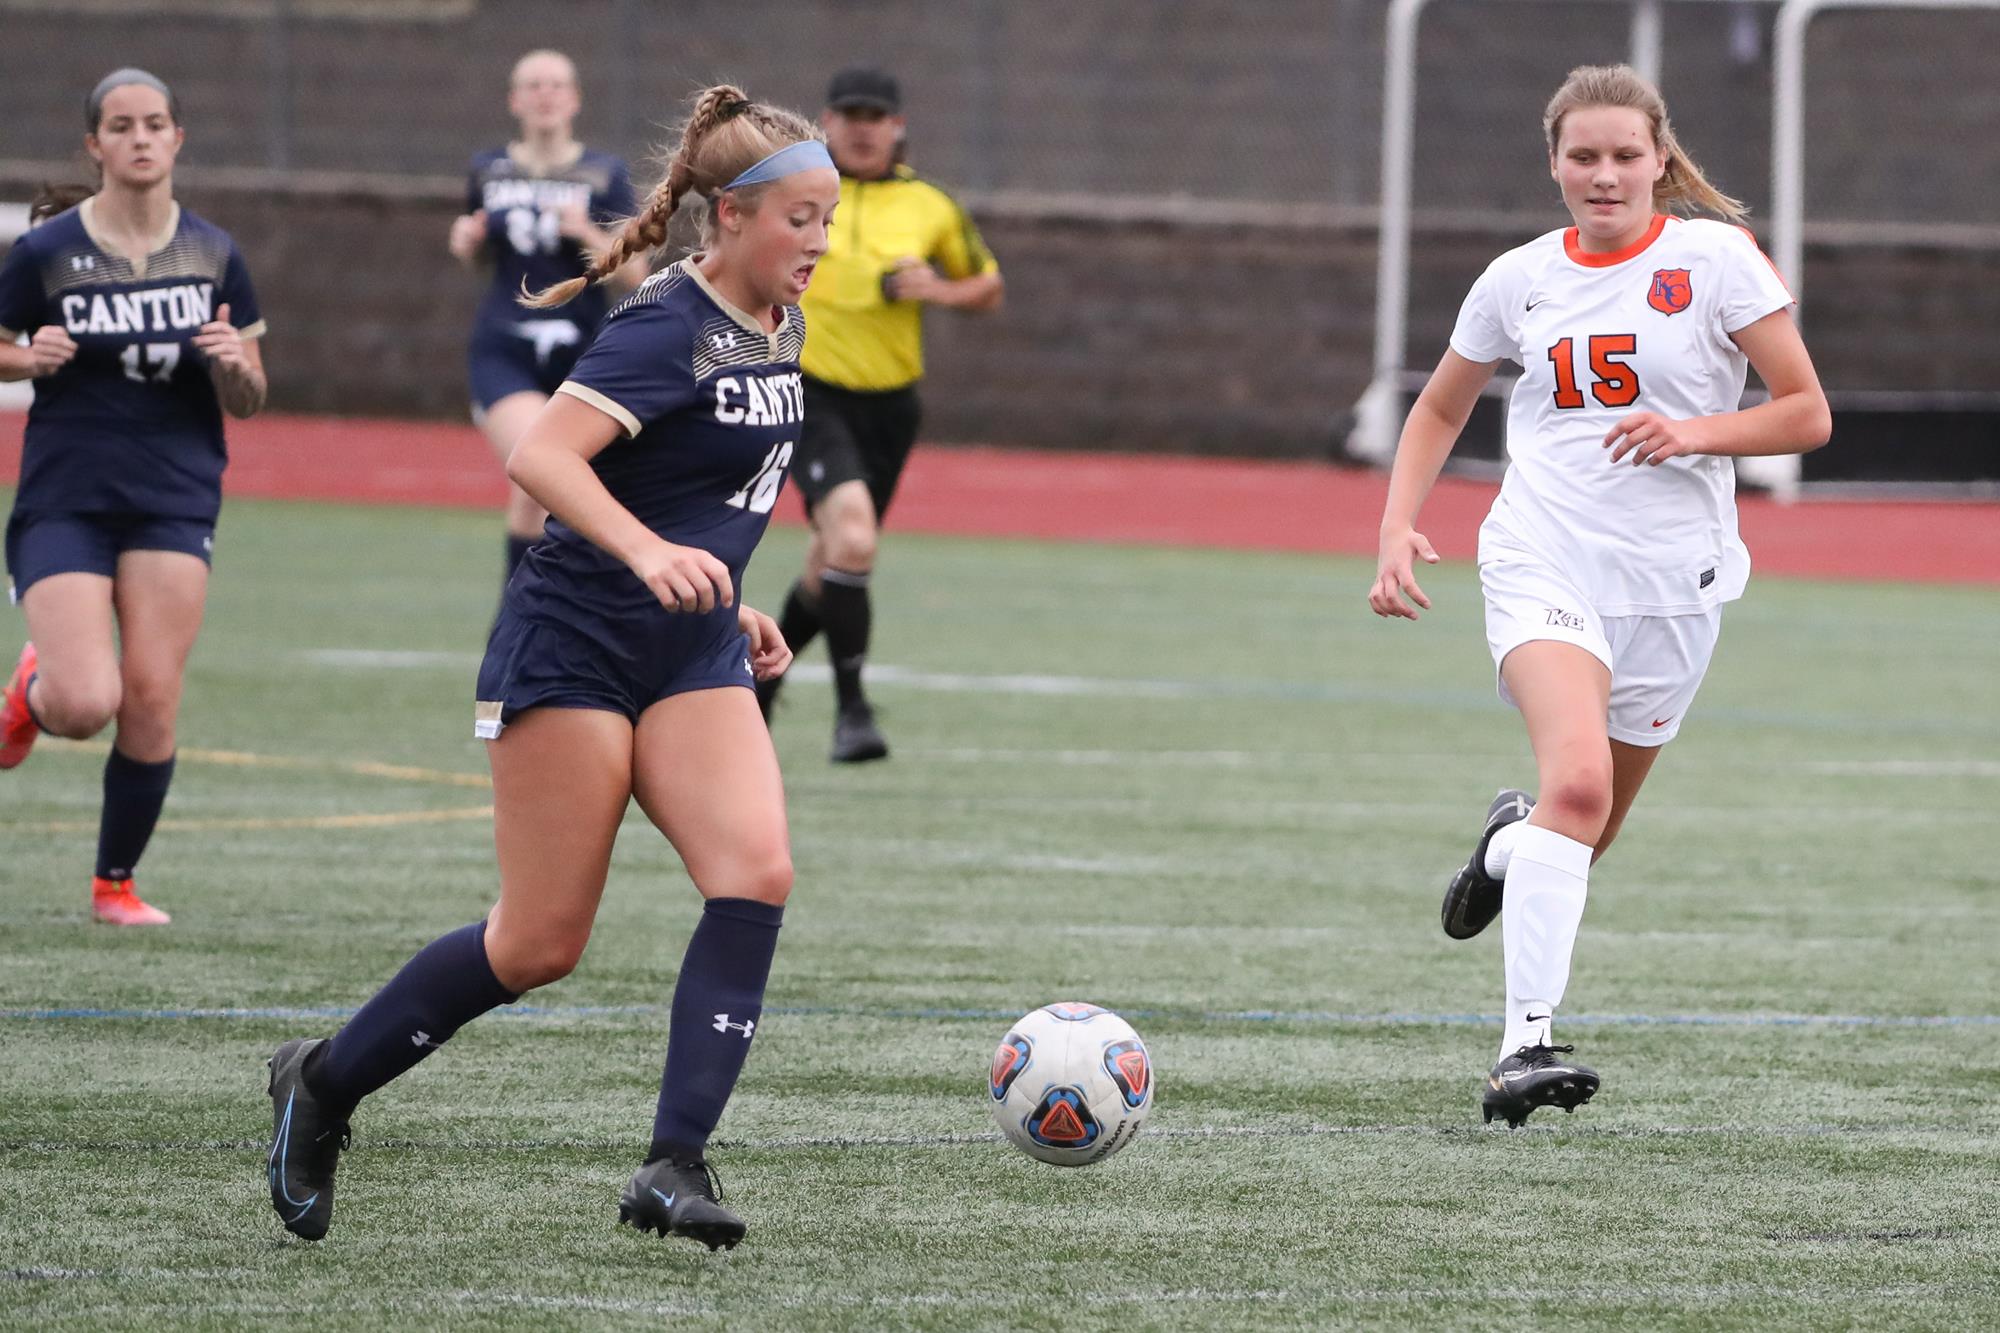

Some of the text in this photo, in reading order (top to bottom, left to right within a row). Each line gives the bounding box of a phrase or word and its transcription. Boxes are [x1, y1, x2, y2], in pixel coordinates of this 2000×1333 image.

[62, 283, 212, 334] CANTON
[119, 343, 180, 382] 17
[1547, 334, 1640, 409] 15
[715, 372, 804, 426] CANTO
[725, 441, 793, 513] 16
